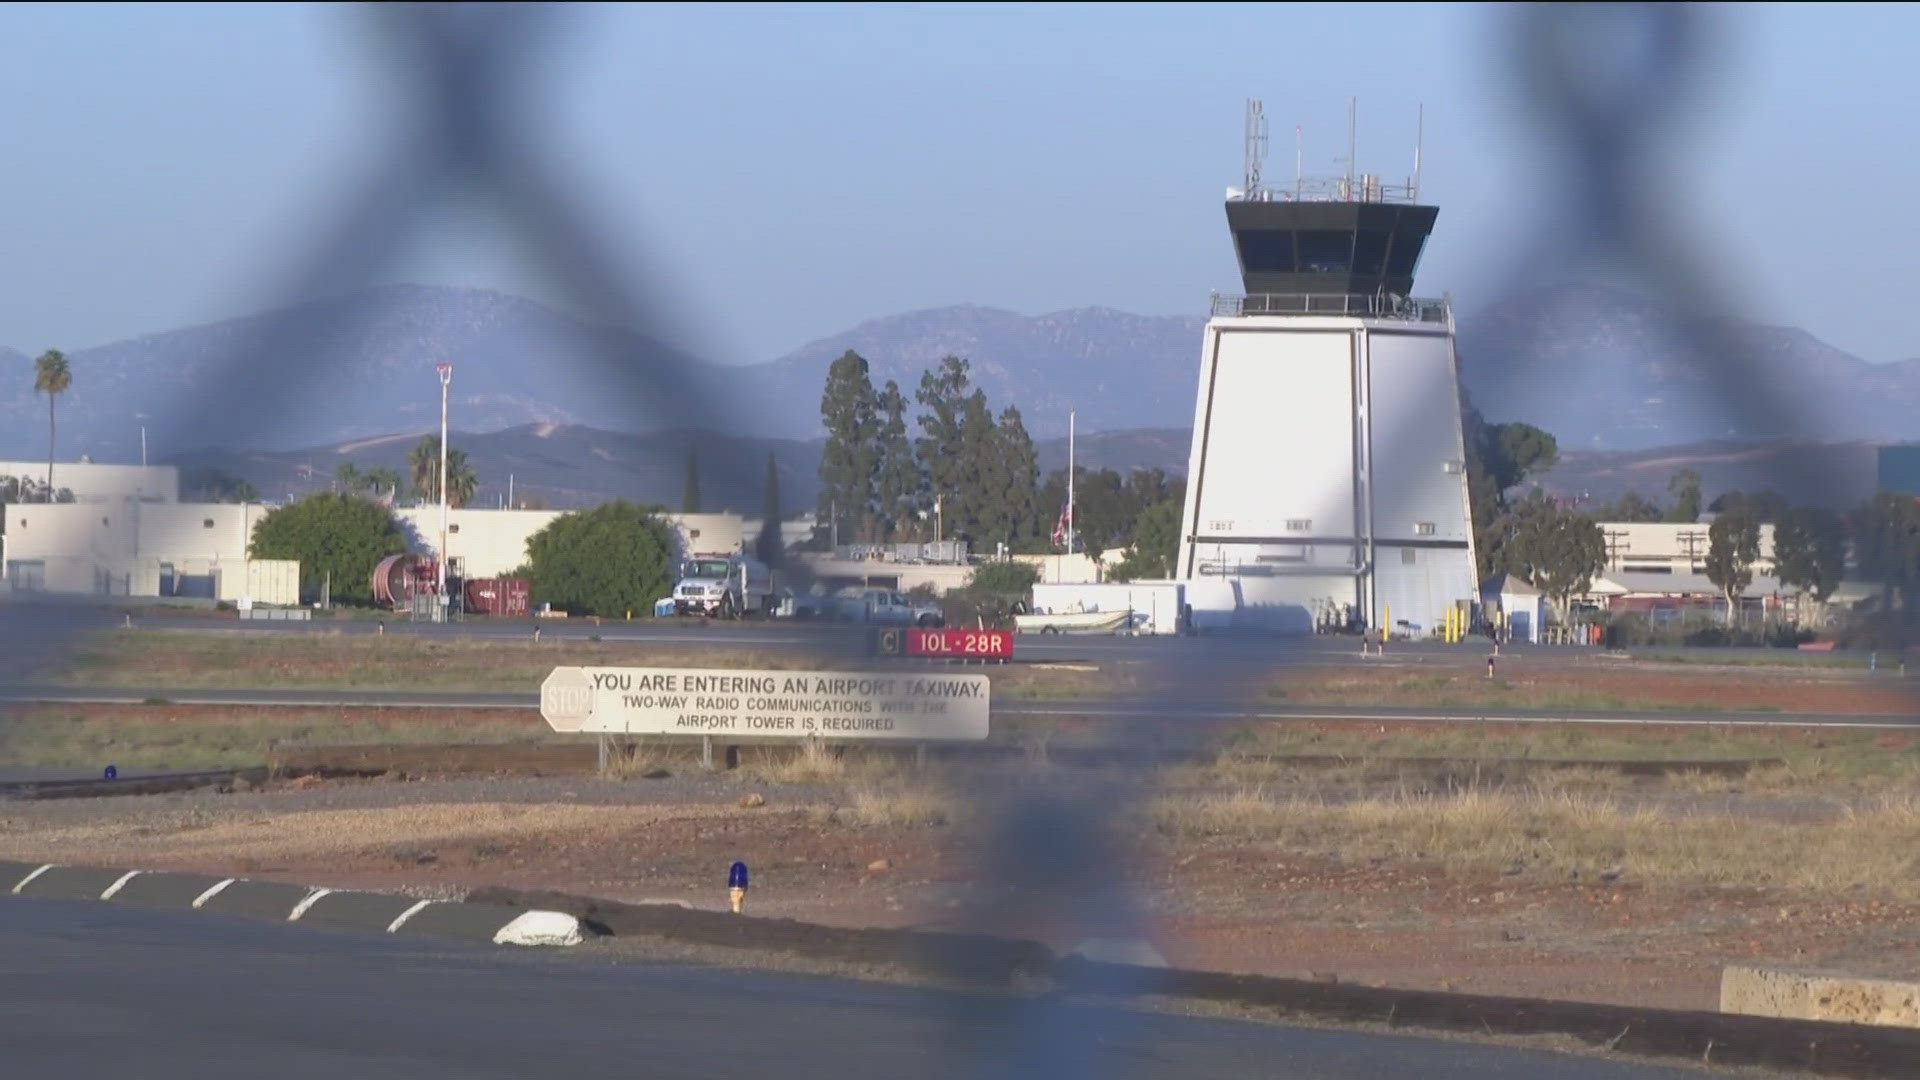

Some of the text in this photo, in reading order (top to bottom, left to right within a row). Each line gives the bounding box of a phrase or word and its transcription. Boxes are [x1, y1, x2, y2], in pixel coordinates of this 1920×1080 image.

[883, 632, 894, 650] C
[593, 673, 632, 691] YOU
[639, 675, 677, 692] ARE
[684, 676, 775, 695] ENTERING
[783, 678, 808, 694] AN
[815, 678, 896, 696] AIRPORT
[549, 686, 590, 713] STOP
[622, 695, 948, 714] TWO-WAY RADIO COMMUNICATIONS WITH THE
[676, 714, 738, 729] AIRPORT
[745, 716, 795, 729] TOWER
[822, 717, 894, 731] REQUIRED
